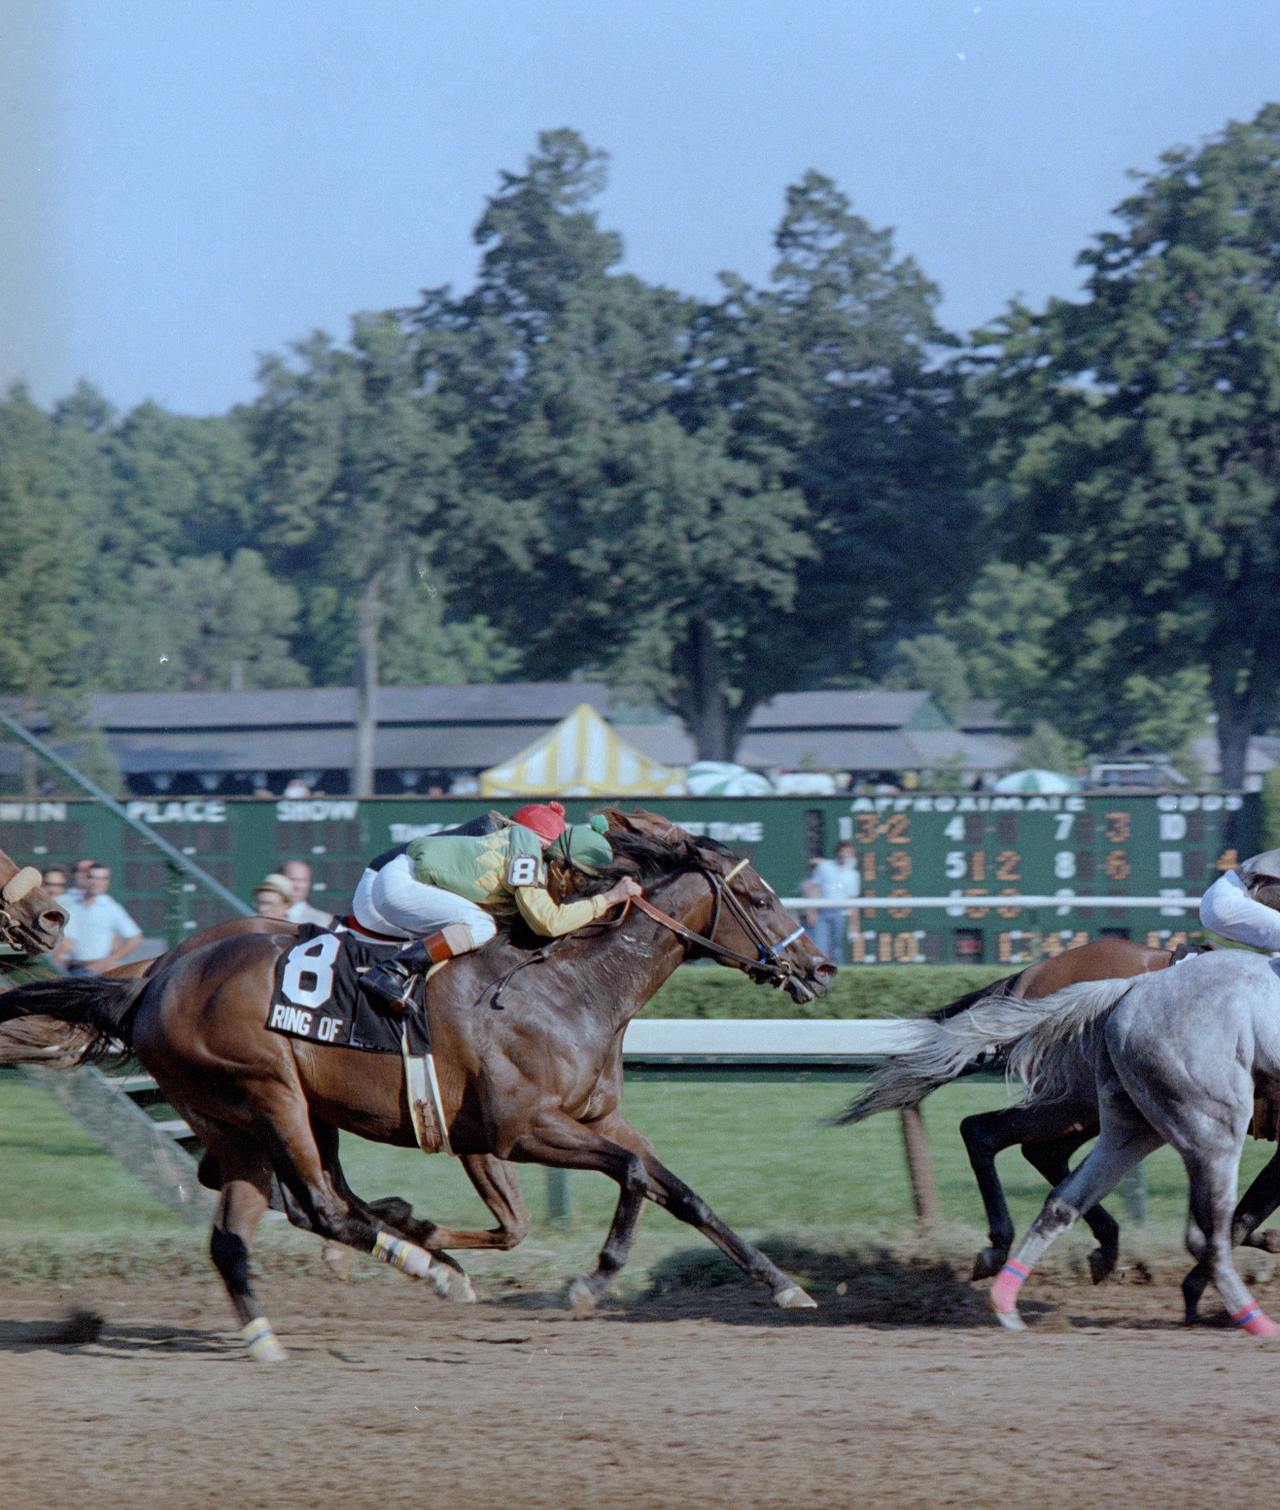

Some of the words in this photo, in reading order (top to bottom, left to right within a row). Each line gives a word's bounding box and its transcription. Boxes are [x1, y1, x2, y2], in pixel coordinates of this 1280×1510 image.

[126, 801, 228, 823] PLACE
[276, 800, 359, 822] SHOW
[850, 797, 1087, 813] APPROXIMATE
[1156, 795, 1244, 812] ODDS
[943, 814, 965, 842] 4
[1054, 813, 1076, 842] 7
[1104, 812, 1132, 844] 3
[513, 857, 538, 886] 8
[944, 850, 968, 880] 5
[1054, 850, 1078, 880] 8
[281, 933, 342, 1009] 8
[270, 1003, 313, 1037] RING
[317, 1015, 343, 1043] OF
